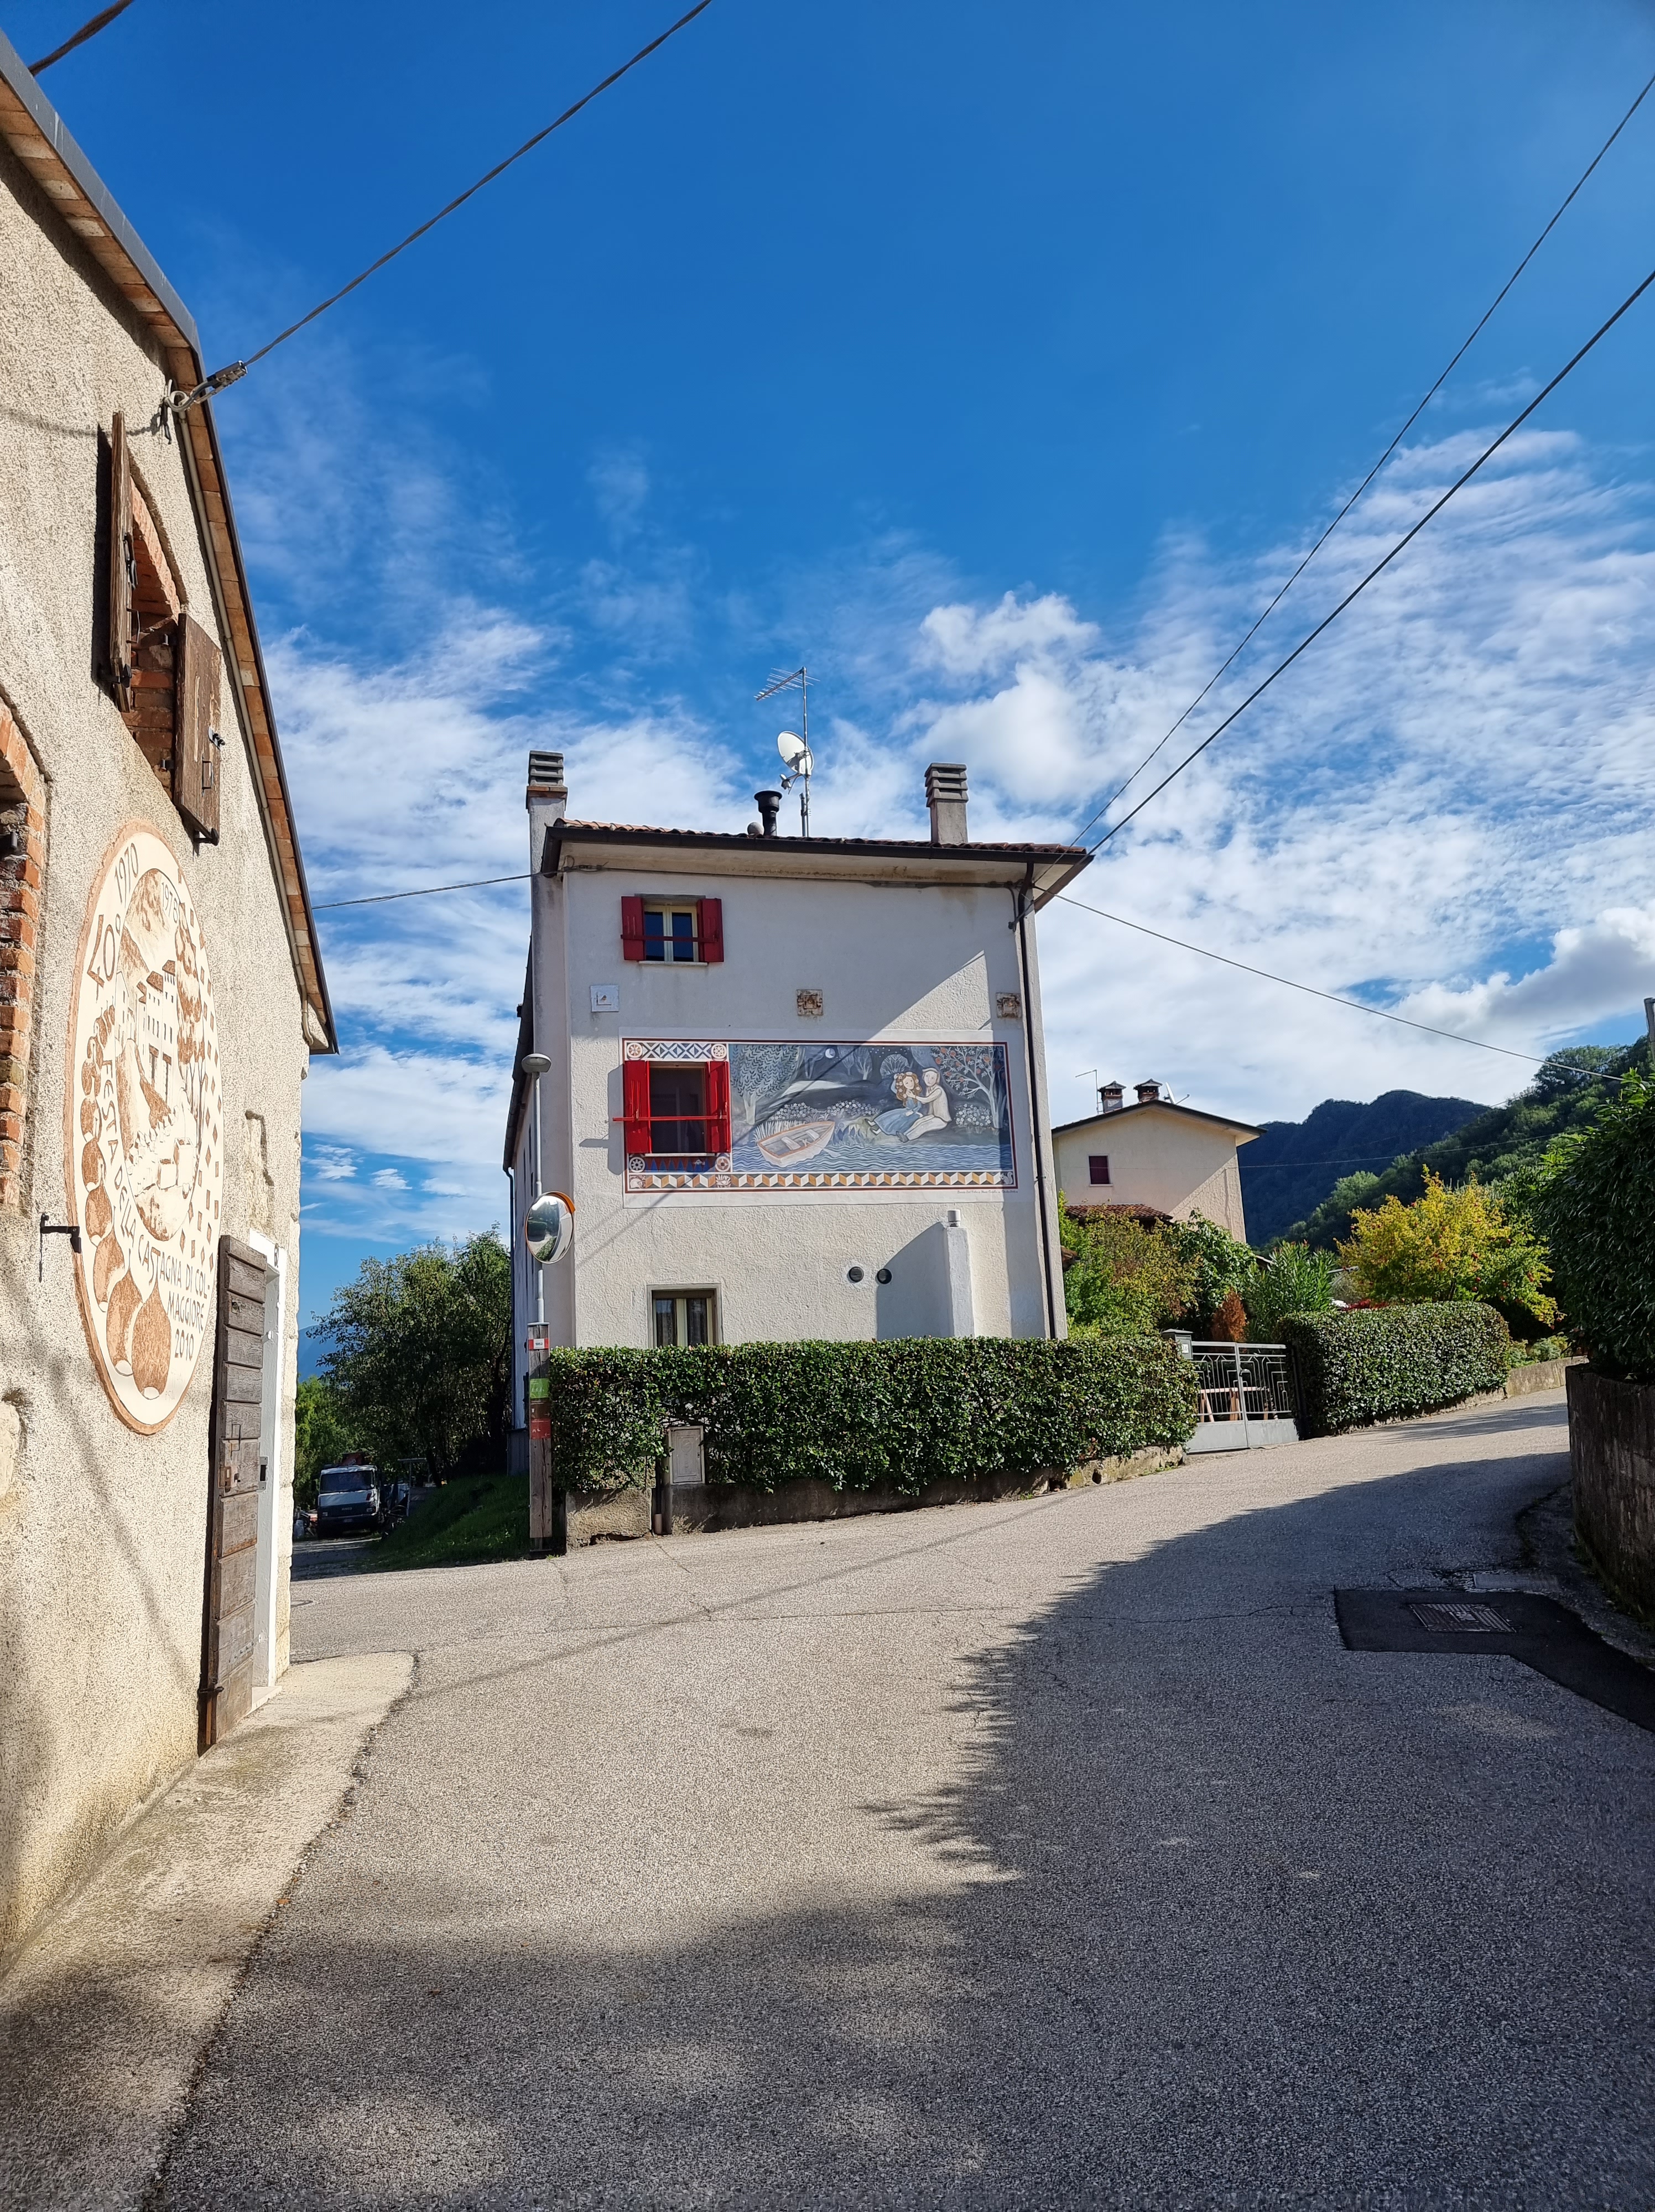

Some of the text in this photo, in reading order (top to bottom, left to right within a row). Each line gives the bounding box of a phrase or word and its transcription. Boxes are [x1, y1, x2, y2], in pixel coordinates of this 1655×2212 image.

[115, 842, 139, 909] 1970
[162, 882, 178, 924] 1978
[101, 1060, 210, 1300] FESTA DELLA CASTAGNA DI COL-
[168, 1290, 205, 1334] MAGGIORE
[174, 1328, 194, 1361] 2010
